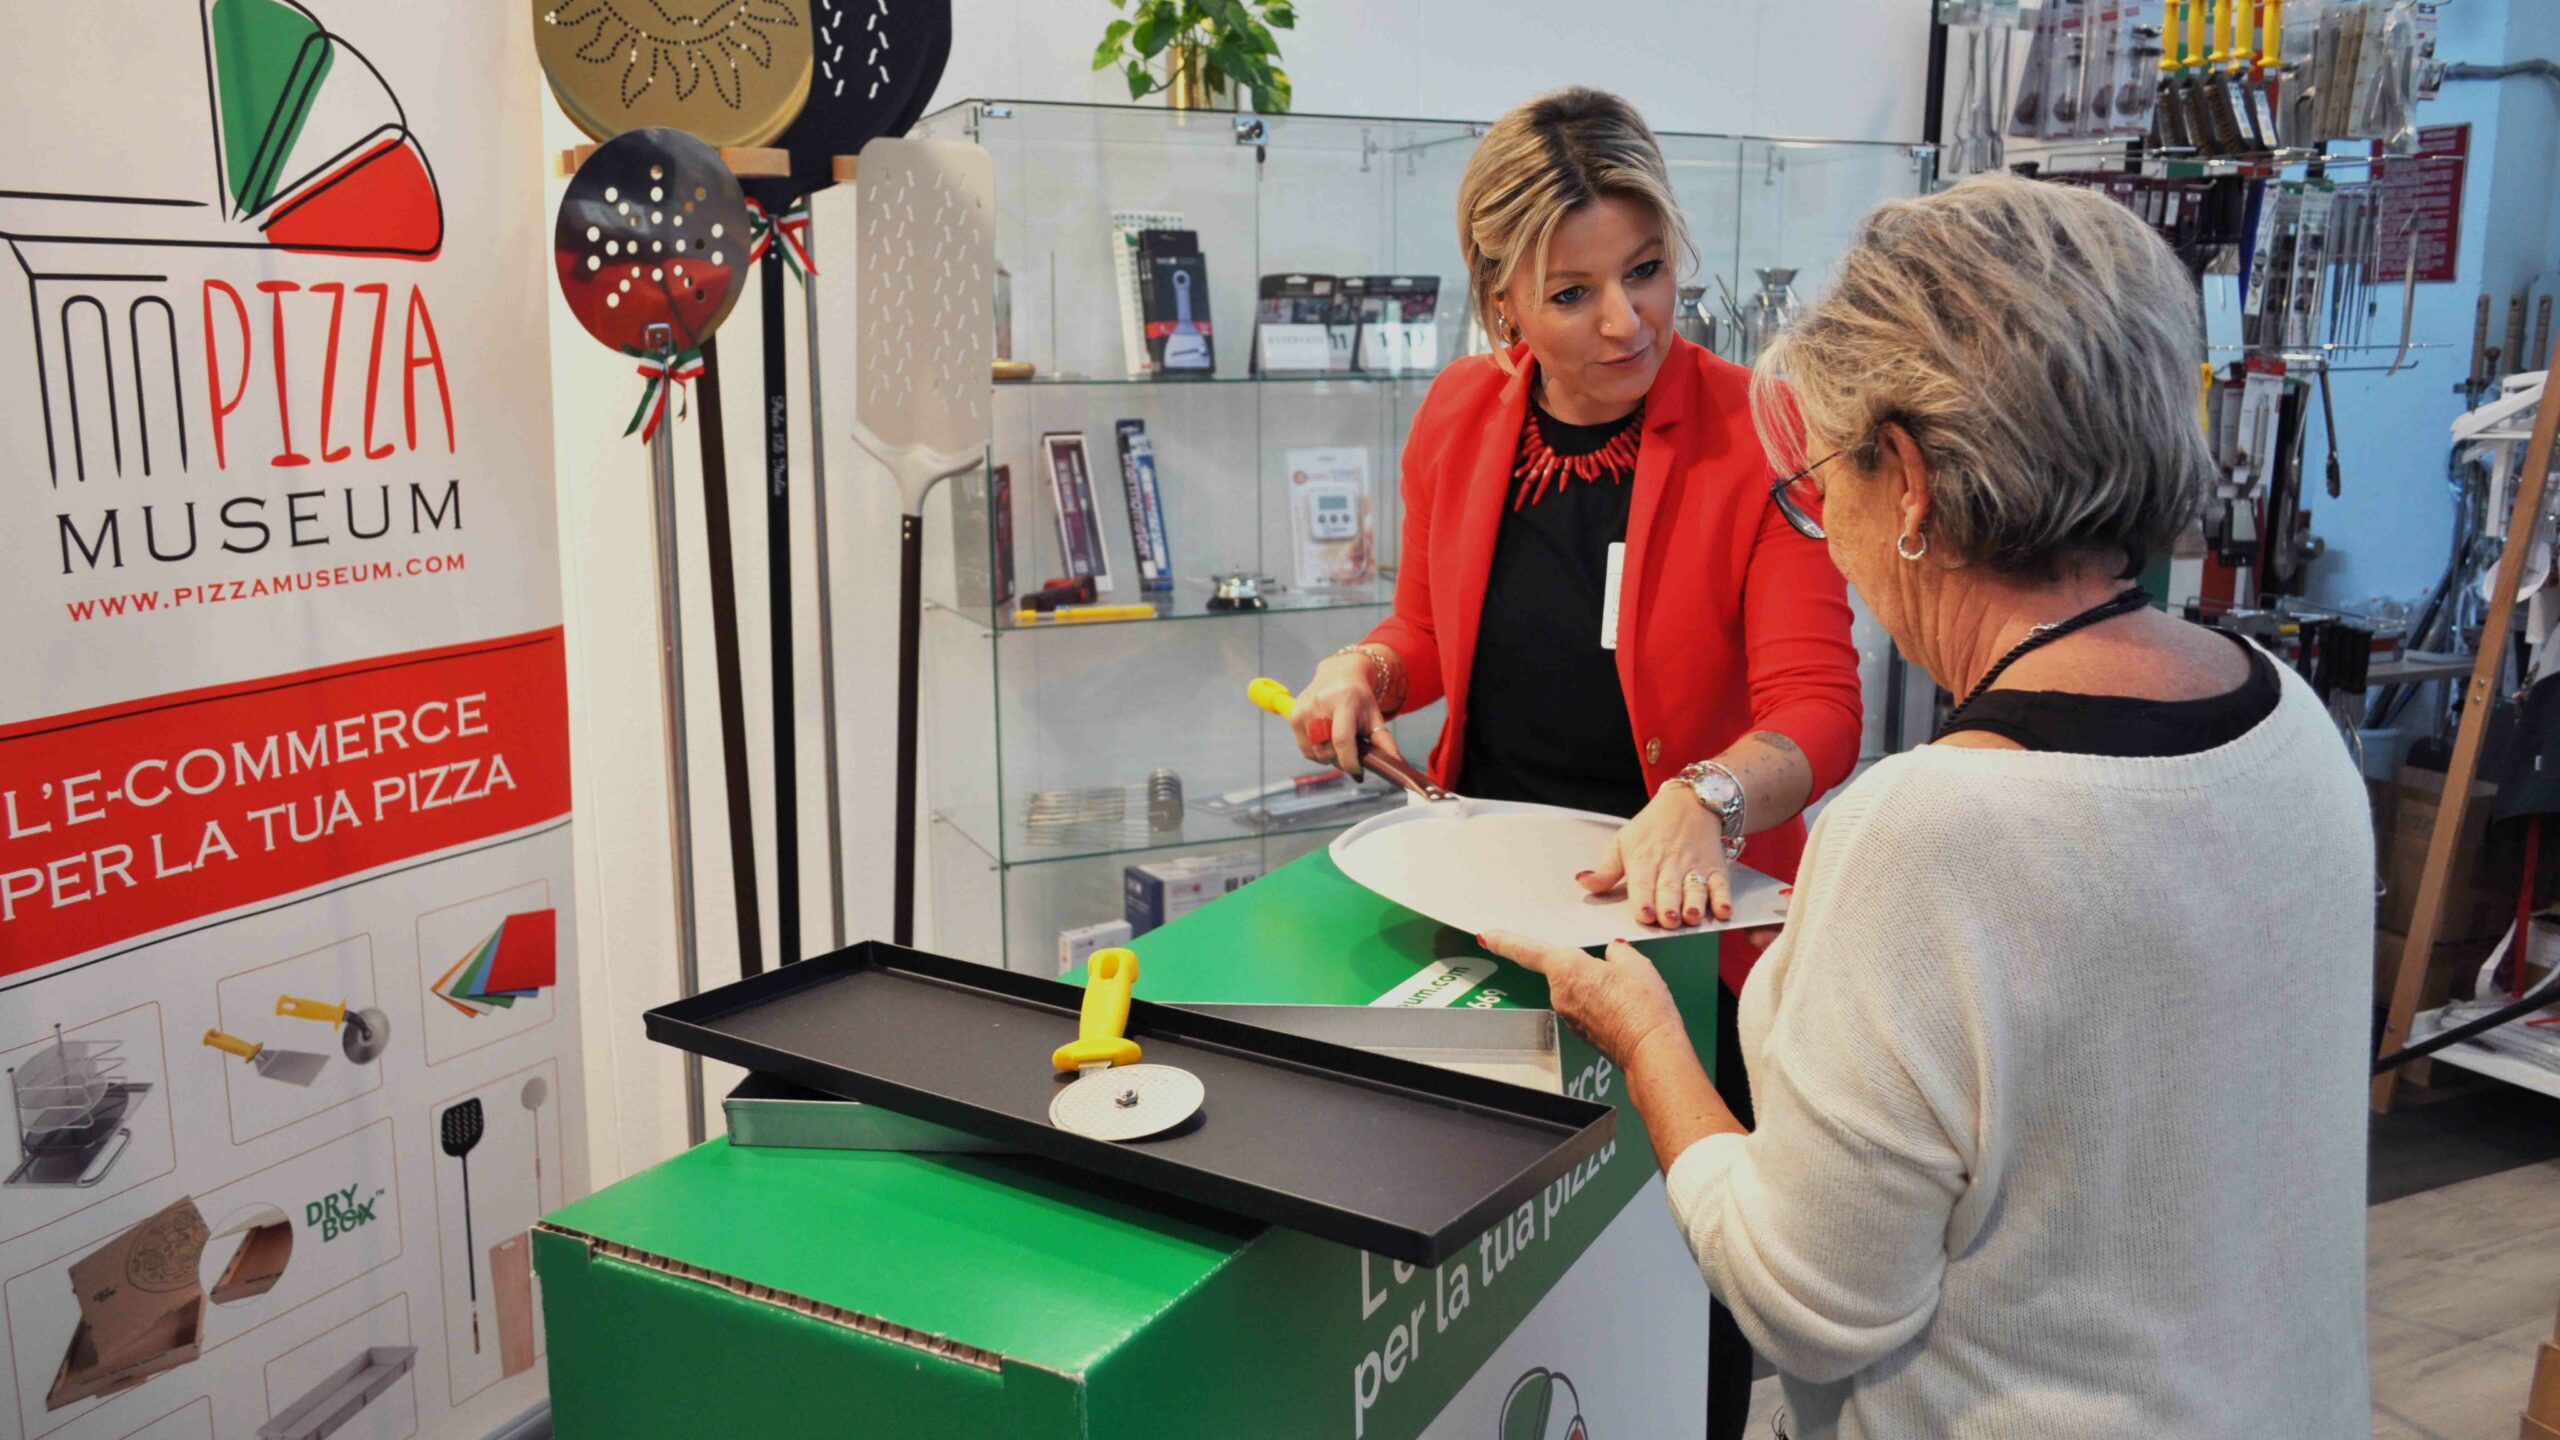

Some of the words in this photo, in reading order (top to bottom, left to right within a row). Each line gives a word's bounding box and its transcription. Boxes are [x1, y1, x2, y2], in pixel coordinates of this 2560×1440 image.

[203, 278, 456, 470] PIZZA
[55, 479, 463, 575] MUSEUM
[66, 553, 467, 623] WWW.PIZZAMUSEUM.COM
[1, 692, 489, 840] L'E-COMMERCE
[0, 842, 137, 921] PER
[151, 820, 238, 879] LA
[247, 789, 362, 853] TUA
[373, 753, 517, 822] PIZZA
[1397, 966, 1472, 1008] um.com
[305, 1183, 359, 1228] DRY
[1355, 1299, 1426, 1440] per
[1436, 1263, 1470, 1334] la
[1479, 1200, 1535, 1287] tua
